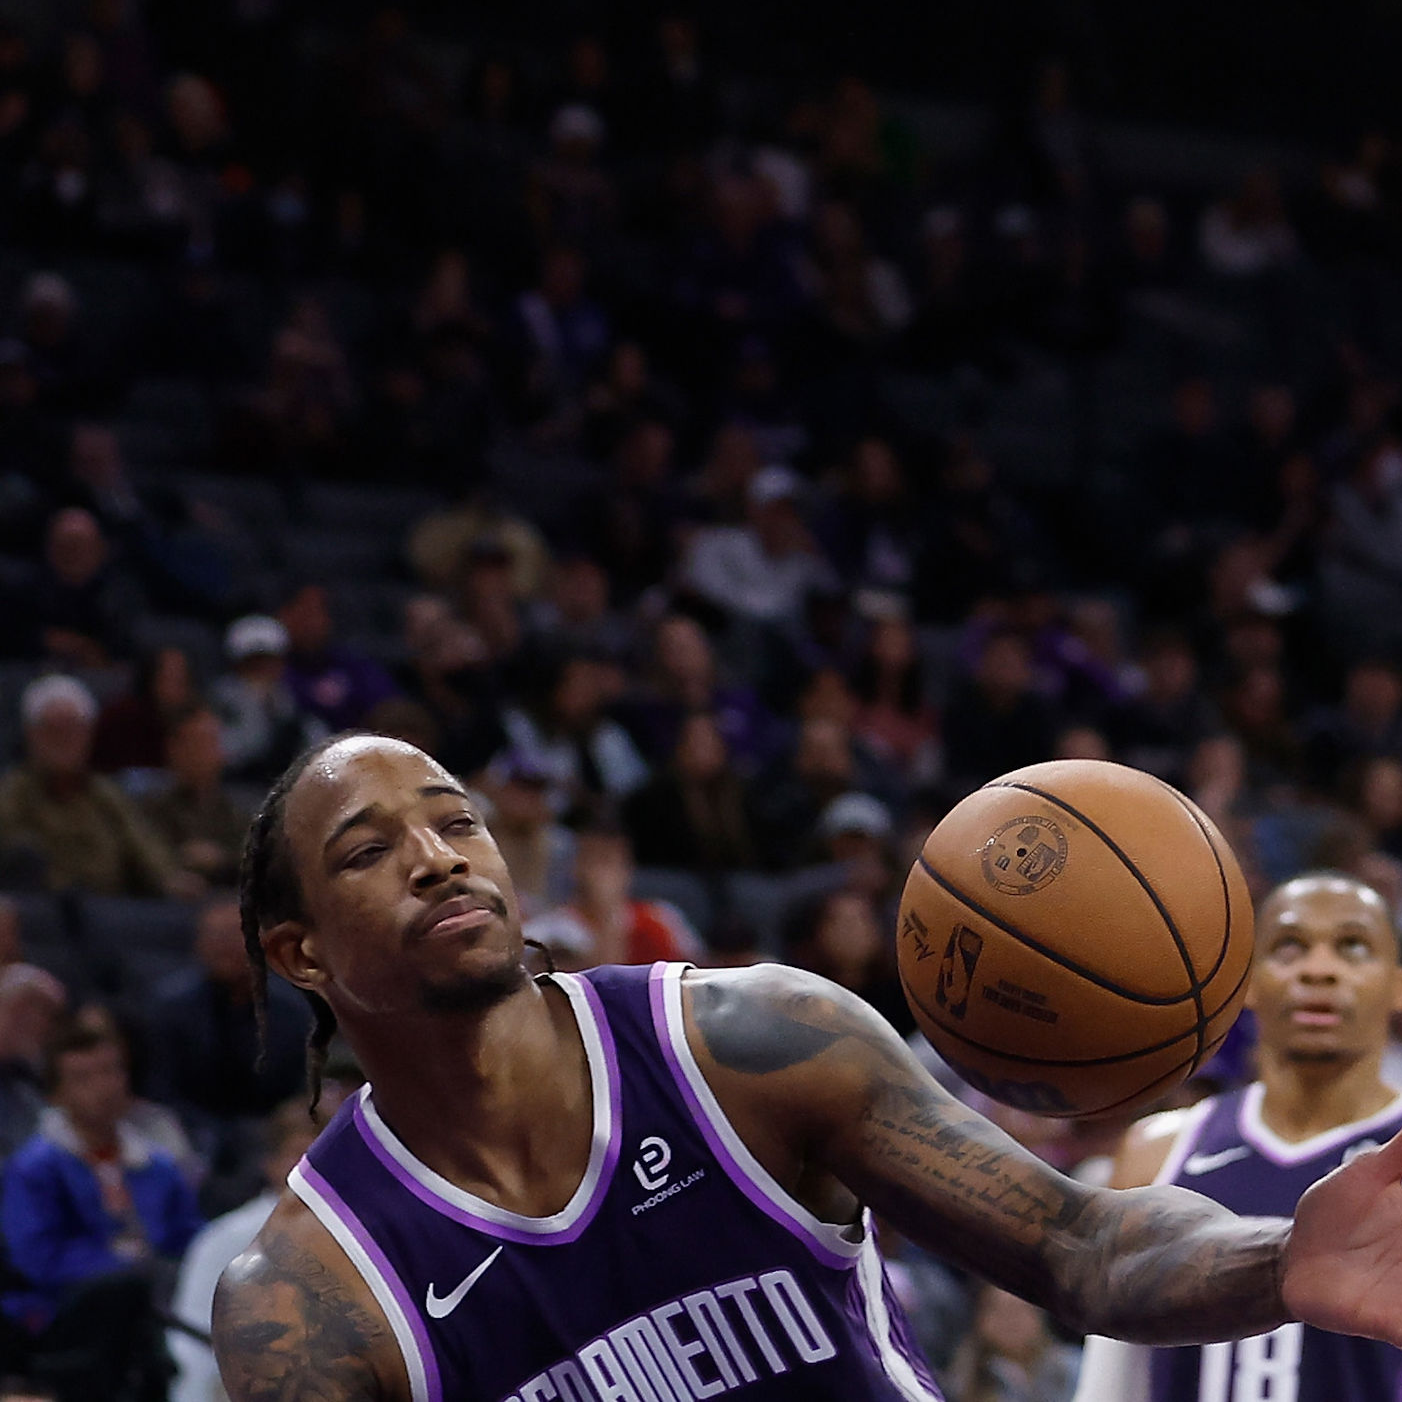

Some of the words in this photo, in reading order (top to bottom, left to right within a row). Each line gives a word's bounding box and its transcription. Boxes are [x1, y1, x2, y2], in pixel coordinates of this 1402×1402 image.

[631, 1182, 682, 1216] PHOONG
[679, 1168, 705, 1188] LAW
[1200, 1322, 1305, 1402] 18
